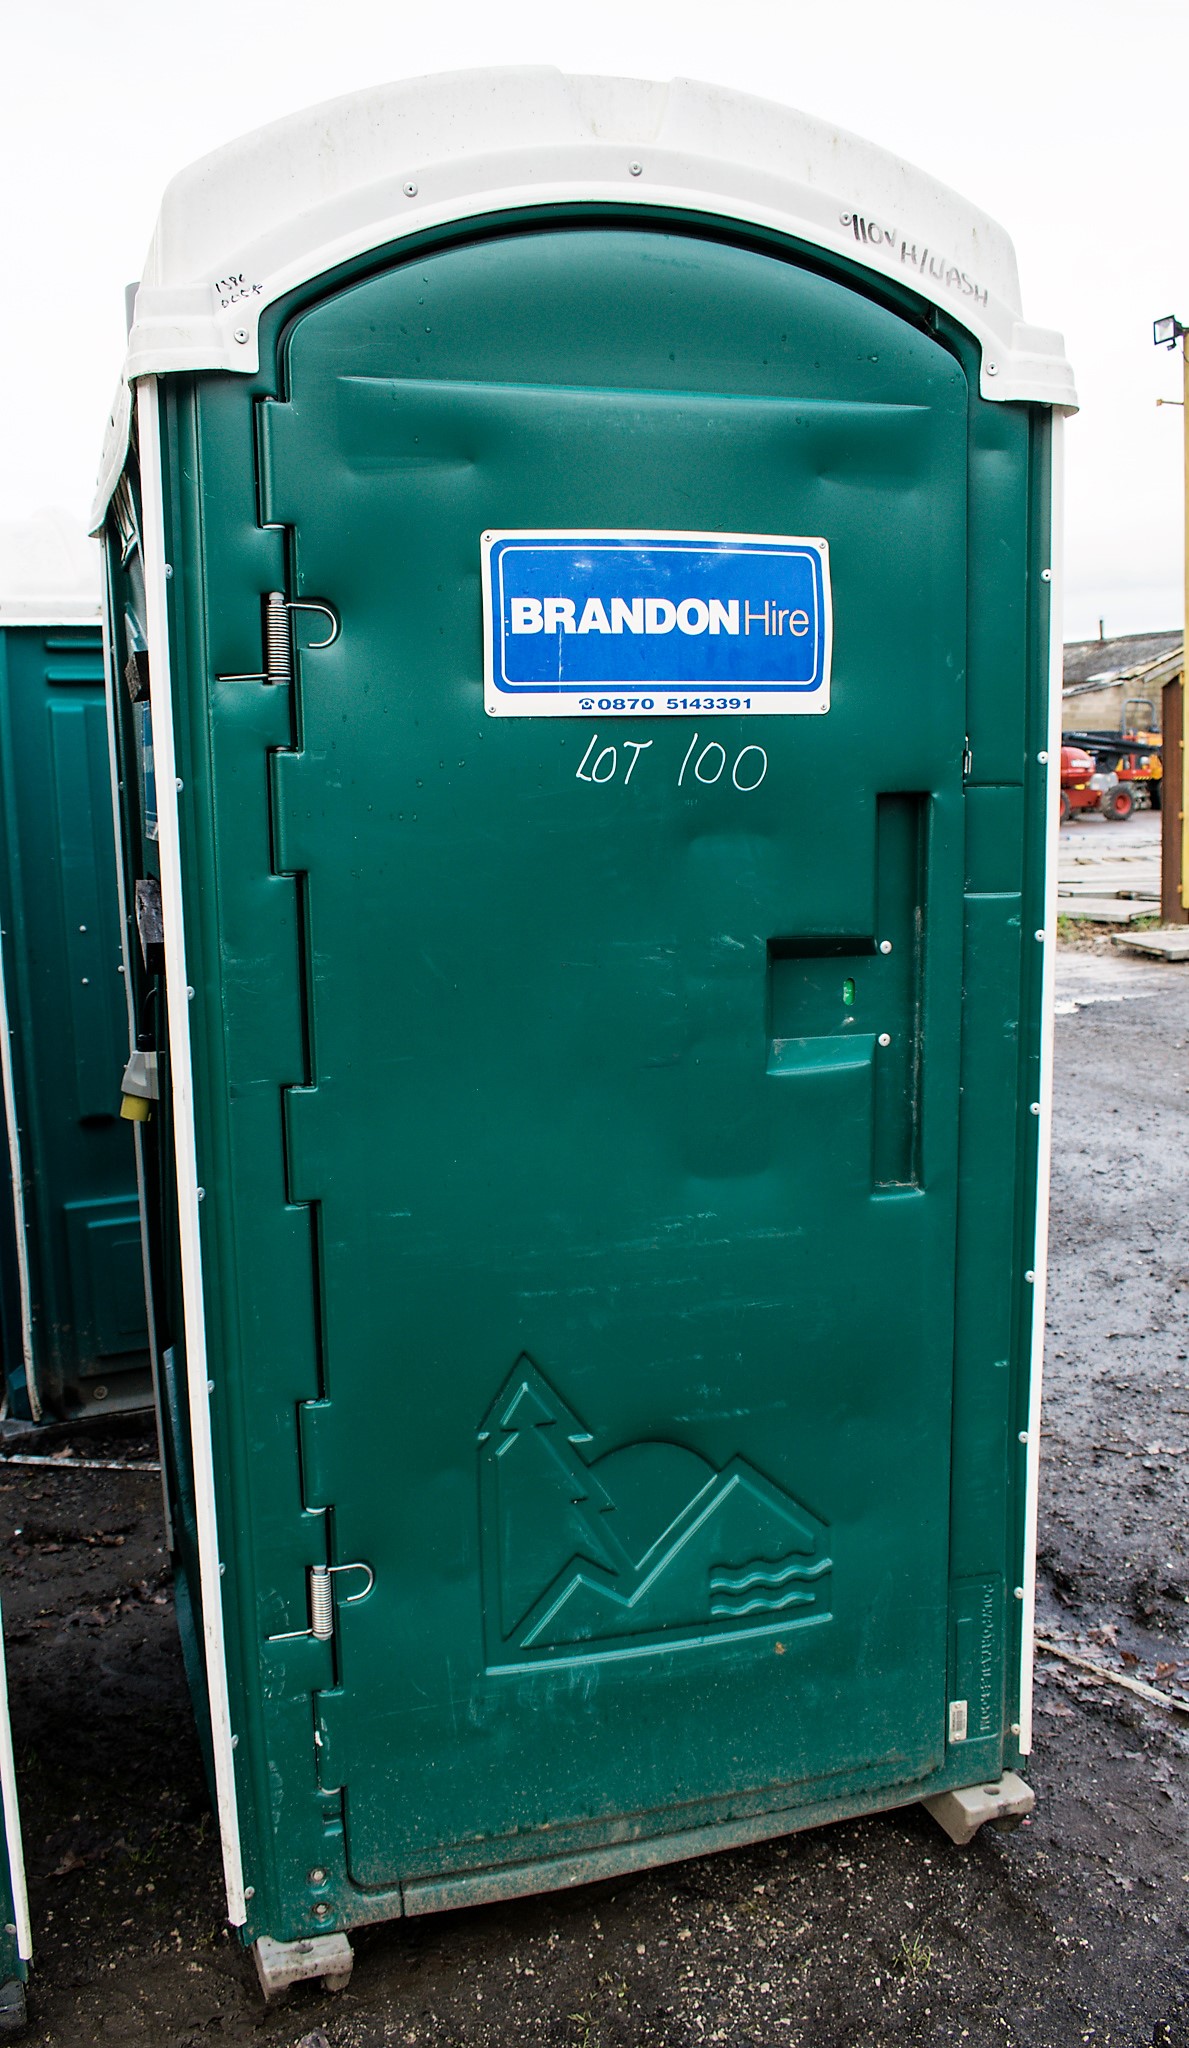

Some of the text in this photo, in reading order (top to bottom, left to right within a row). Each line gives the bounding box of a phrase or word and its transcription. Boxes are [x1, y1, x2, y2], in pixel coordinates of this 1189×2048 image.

[510, 597, 810, 637] BRANDON Hire
[597, 698, 752, 710] 0870 5143391
[575, 732, 768, 792] LOT 100
